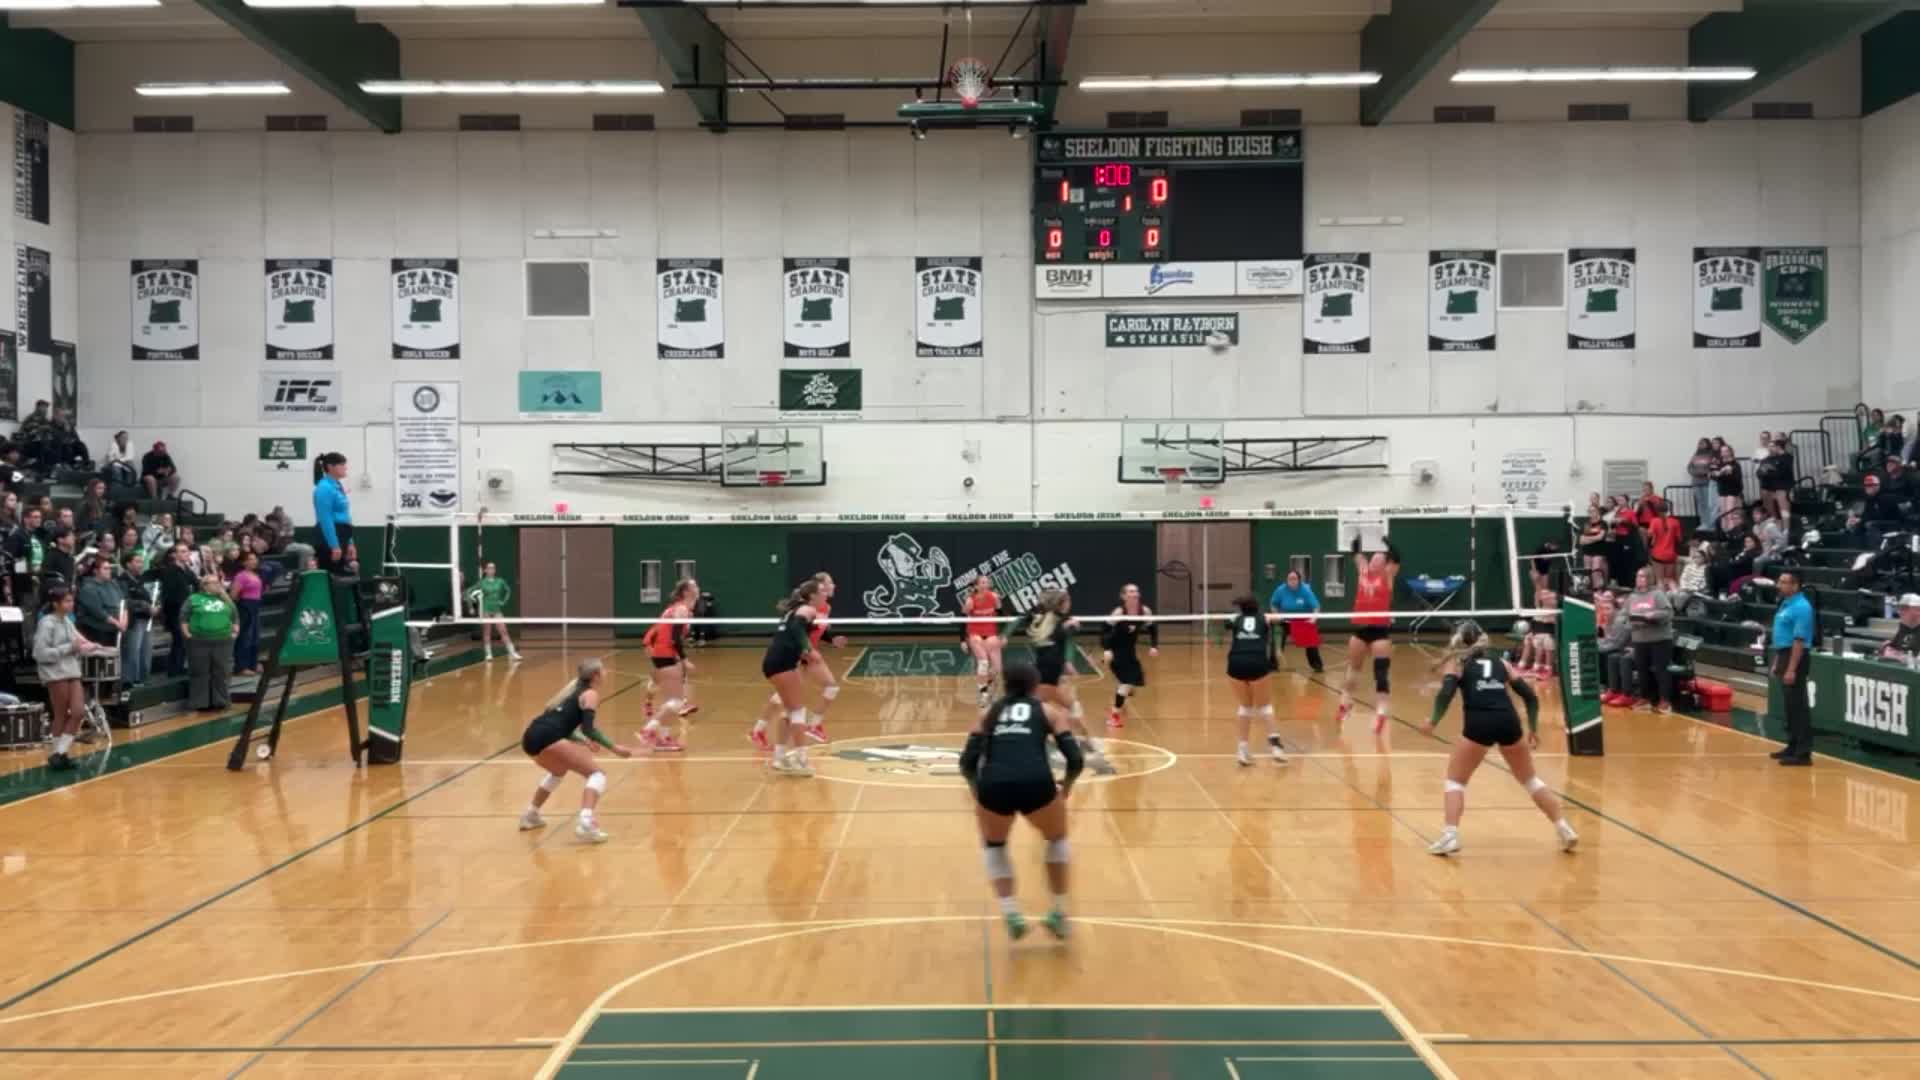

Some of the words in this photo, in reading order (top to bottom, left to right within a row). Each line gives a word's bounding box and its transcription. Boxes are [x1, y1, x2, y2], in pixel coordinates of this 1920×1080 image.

[1065, 137, 1141, 158] SHELDON
[1144, 136, 1223, 158] FIGHTING
[1227, 135, 1273, 156] IRISH
[1062, 180, 1069, 202] 1
[1152, 178, 1168, 202] 0
[1124, 195, 1132, 211] 1
[1050, 229, 1062, 247] 0
[1100, 229, 1111, 246] 0
[1147, 229, 1159, 246] 0
[921, 268, 976, 287] STATE
[1045, 269, 1093, 283] BMH
[1309, 264, 1365, 282] STATE
[1434, 263, 1490, 281] STATE
[1573, 262, 1630, 280] STATE
[1699, 259, 1755, 278] STATE
[1779, 265, 1809, 275] CUP
[137, 270, 193, 288] STATE
[271, 270, 327, 288] STATE
[397, 270, 453, 288] STATE
[662, 270, 718, 288] STATE
[789, 269, 845, 287] STATE
[1309, 279, 1365, 294] CHAMPIONS
[1435, 277, 1490, 292] CHAMPIONS
[1574, 275, 1630, 290] CHAMPIONS
[1699, 273, 1755, 288] CHAMPIONS
[17, 247, 28, 347] WRESTLING
[137, 285, 193, 300] CHAMPIONS
[271, 285, 327, 300] CHAMPIONS
[398, 285, 454, 300] CHAMPIONS
[663, 284, 718, 299] CHAMPIONS
[789, 283, 845, 298] CHAMPIONS
[921, 283, 976, 298] CHAMPIONS
[1109, 317, 1170, 332] CAROLYN
[1173, 316, 1235, 331] RAYBORN
[1129, 334, 1204, 345] GYMNASIU
[274, 379, 332, 403] IFC
[953, 568, 978, 591] HOME
[992, 549, 1011, 567] THE
[1009, 562, 1077, 614] IRISH
[391, 649, 402, 703] SHELDON
[1475, 659, 1492, 678] 7
[1569, 641, 1582, 696] SHELDON
[1845, 673, 1909, 735] IRISH
